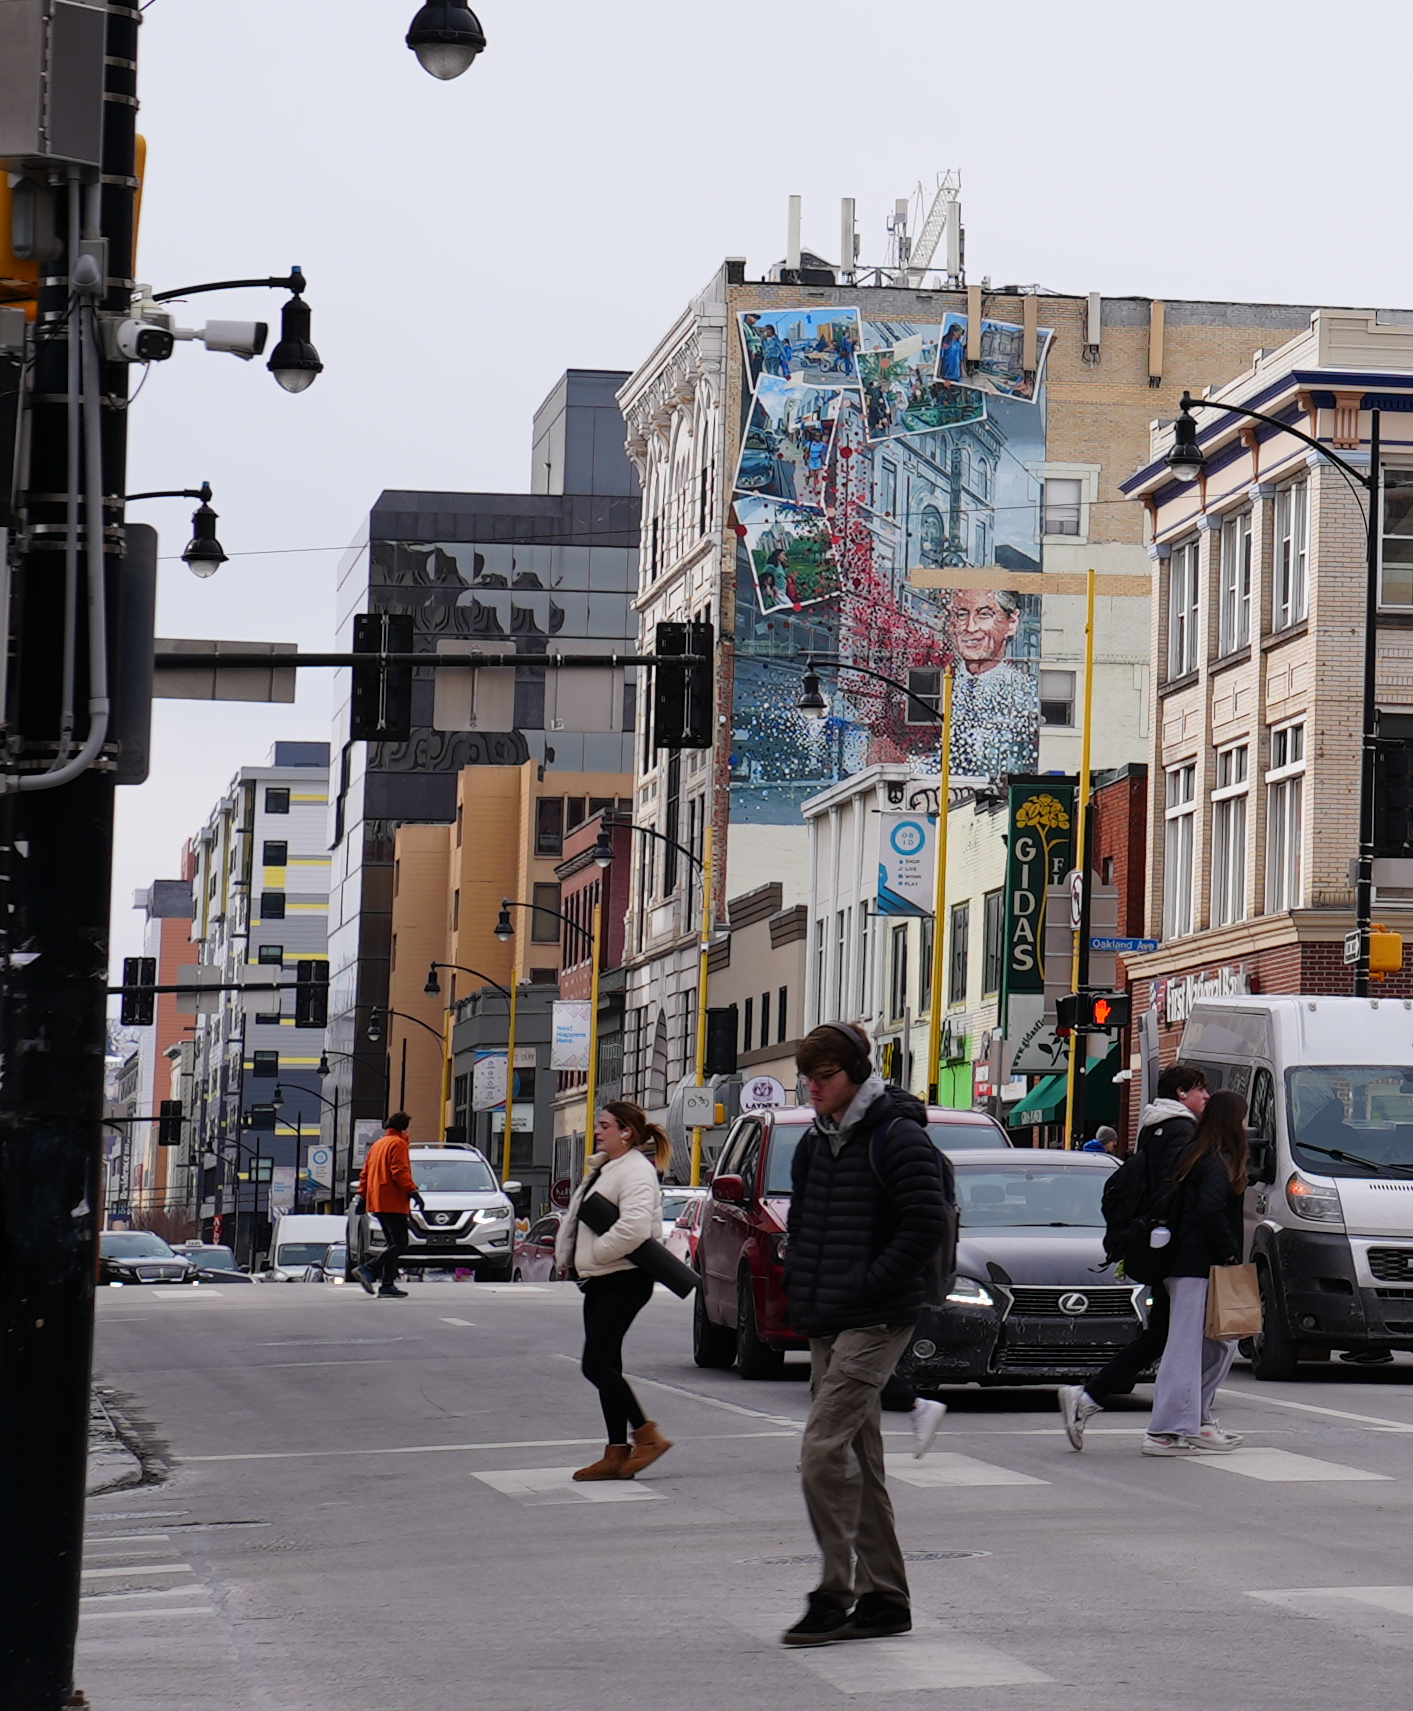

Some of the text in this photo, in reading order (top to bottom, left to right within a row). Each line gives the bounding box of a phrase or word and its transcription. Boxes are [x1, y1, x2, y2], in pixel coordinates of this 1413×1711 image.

[1012, 837, 1037, 971] GIDAS
[1092, 938, 1156, 951] Oakland Ave
[1166, 962, 1247, 1023] First National Bank
[1012, 1019, 1045, 1067] www.gidasfl
